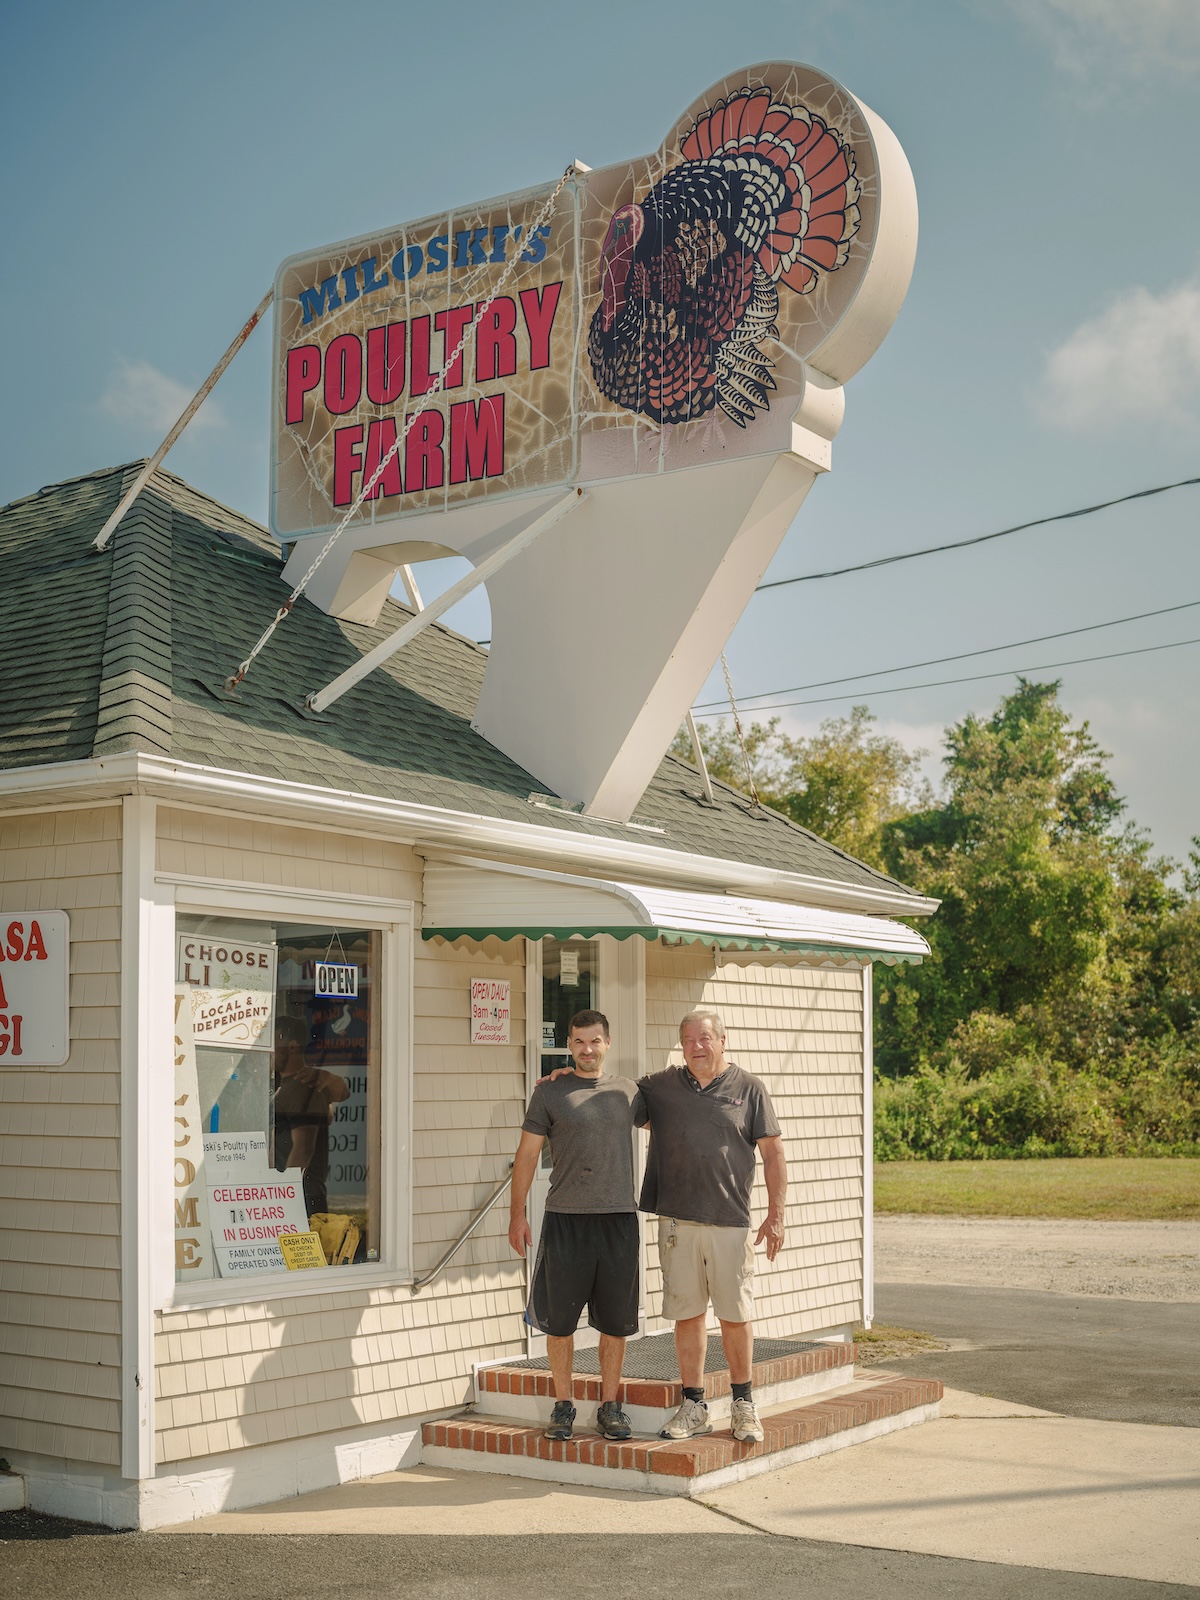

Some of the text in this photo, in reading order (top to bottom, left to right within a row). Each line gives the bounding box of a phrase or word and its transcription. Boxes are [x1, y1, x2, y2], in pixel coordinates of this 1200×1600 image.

[299, 225, 552, 325] MILOSKI'S
[286, 281, 563, 425] POULTRY
[333, 393, 505, 507] FARM
[0, 920, 47, 961] SA
[185, 943, 268, 968] CHOOSE
[319, 966, 355, 994] OPEN
[472, 982, 509, 1001] OPEN DAILY
[201, 996, 253, 1019] LOCAL &
[473, 1004, 488, 1019] 9am
[493, 1007, 509, 1022] 4pm
[480, 1022, 503, 1032] Closed
[475, 1032, 507, 1042] Tuesdays
[223, 1141, 248, 1152] Poultry
[250, 1140, 266, 1150] Farm
[216, 1153, 246, 1162] Since 1946
[214, 1186, 295, 1202] CELEBRATING
[246, 1206, 285, 1221] YEARS
[224, 1224, 298, 1241] IN BUSINESS
[283, 1236, 315, 1247] CASH ONLY
[229, 1249, 255, 1258] FAMILY
[228, 1259, 268, 1271] OPERATED
